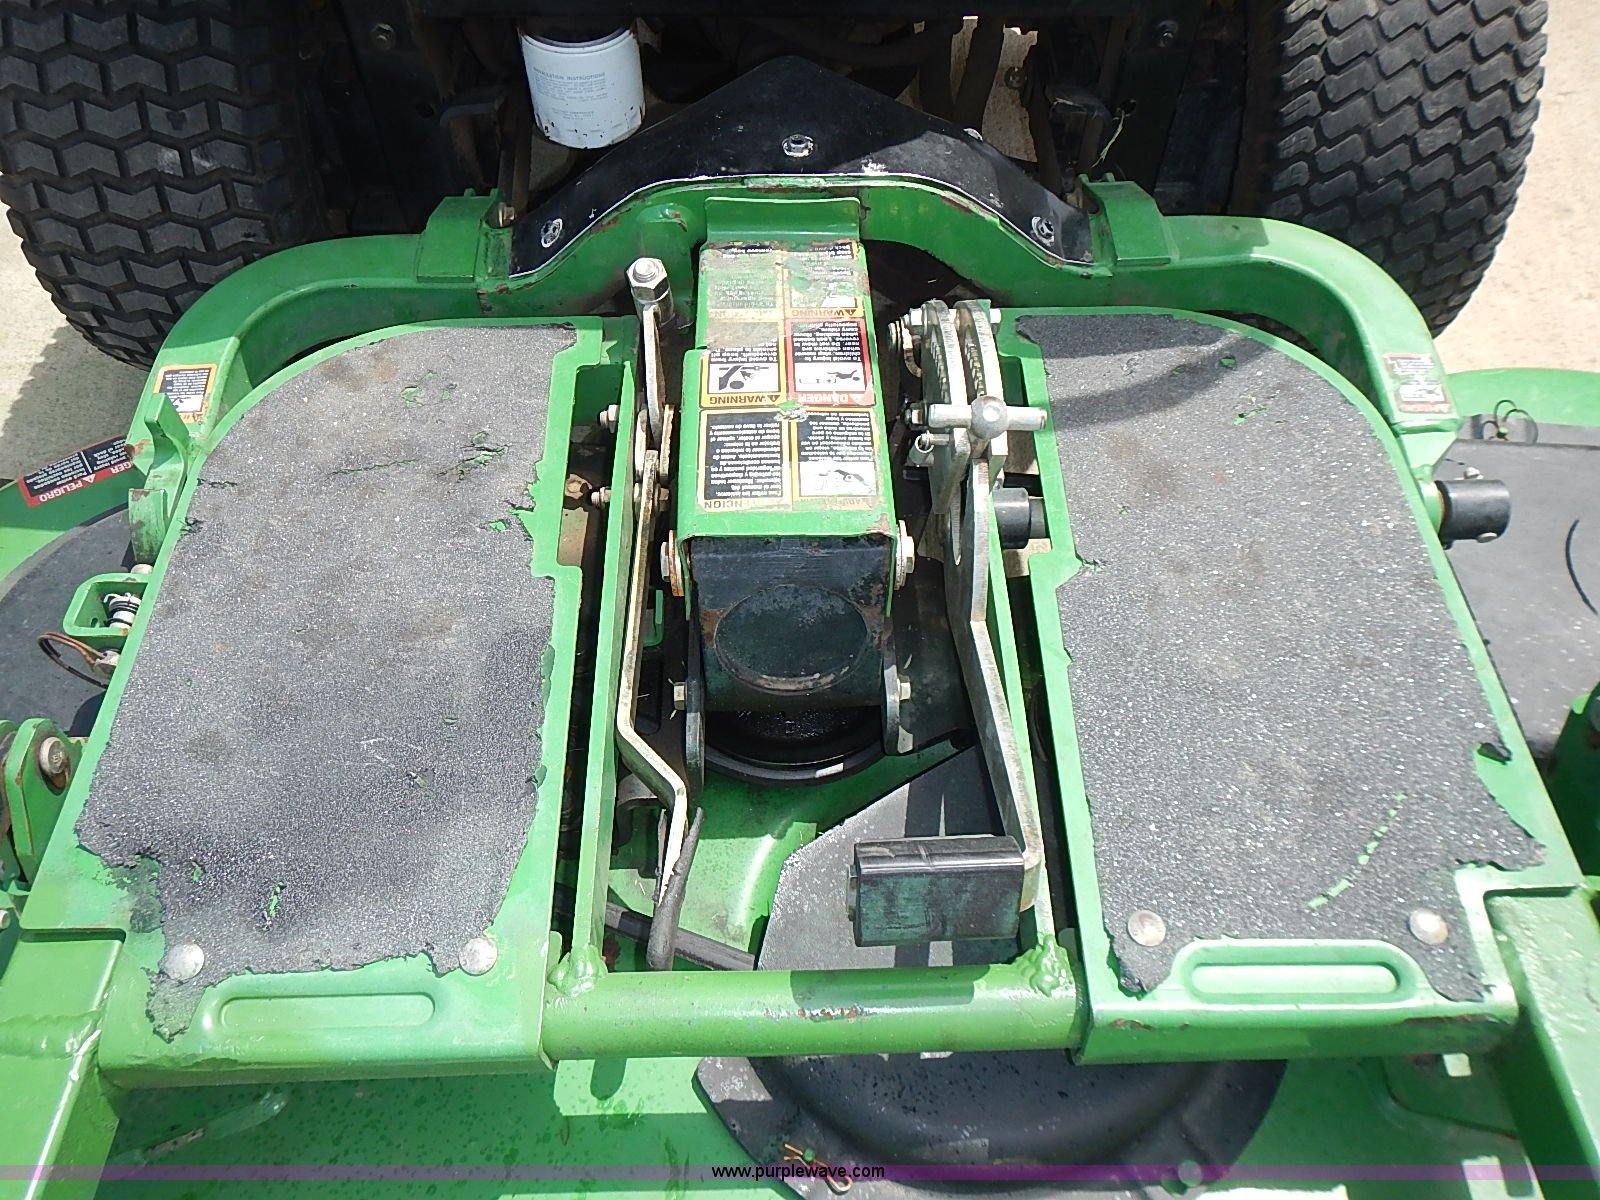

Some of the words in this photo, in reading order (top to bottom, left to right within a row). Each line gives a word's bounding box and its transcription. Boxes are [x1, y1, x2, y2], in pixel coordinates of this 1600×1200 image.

[709, 395, 765, 404] WARNING
[798, 394, 849, 403] DANGER
[39, 479, 83, 502] PELIGRO
